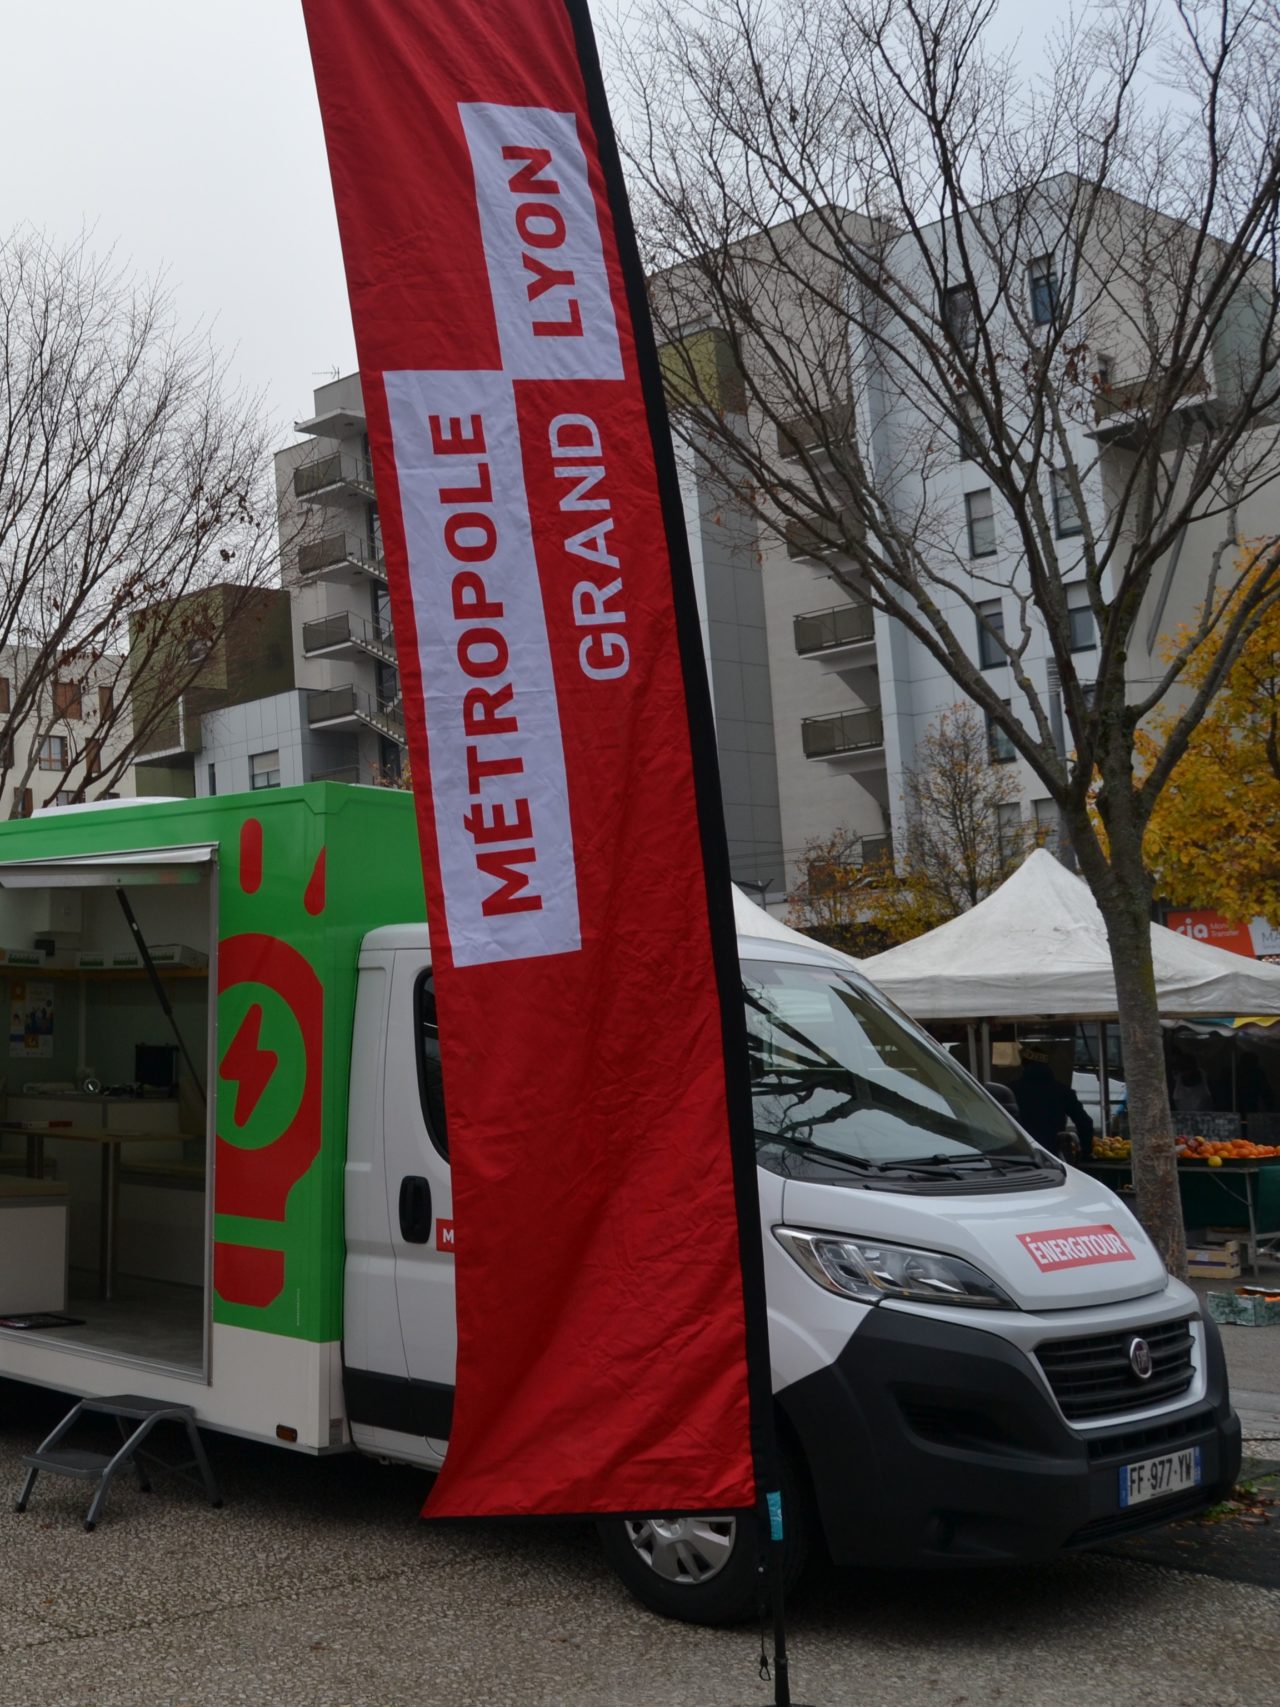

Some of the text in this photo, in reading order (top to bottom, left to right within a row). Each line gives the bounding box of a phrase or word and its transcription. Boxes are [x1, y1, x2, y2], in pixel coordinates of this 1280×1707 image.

[429, 412, 543, 919] MÉTROPOLE
[501, 145, 630, 681] GRAND LYON
[1025, 1232, 1129, 1265] ÉNERGITOUR
